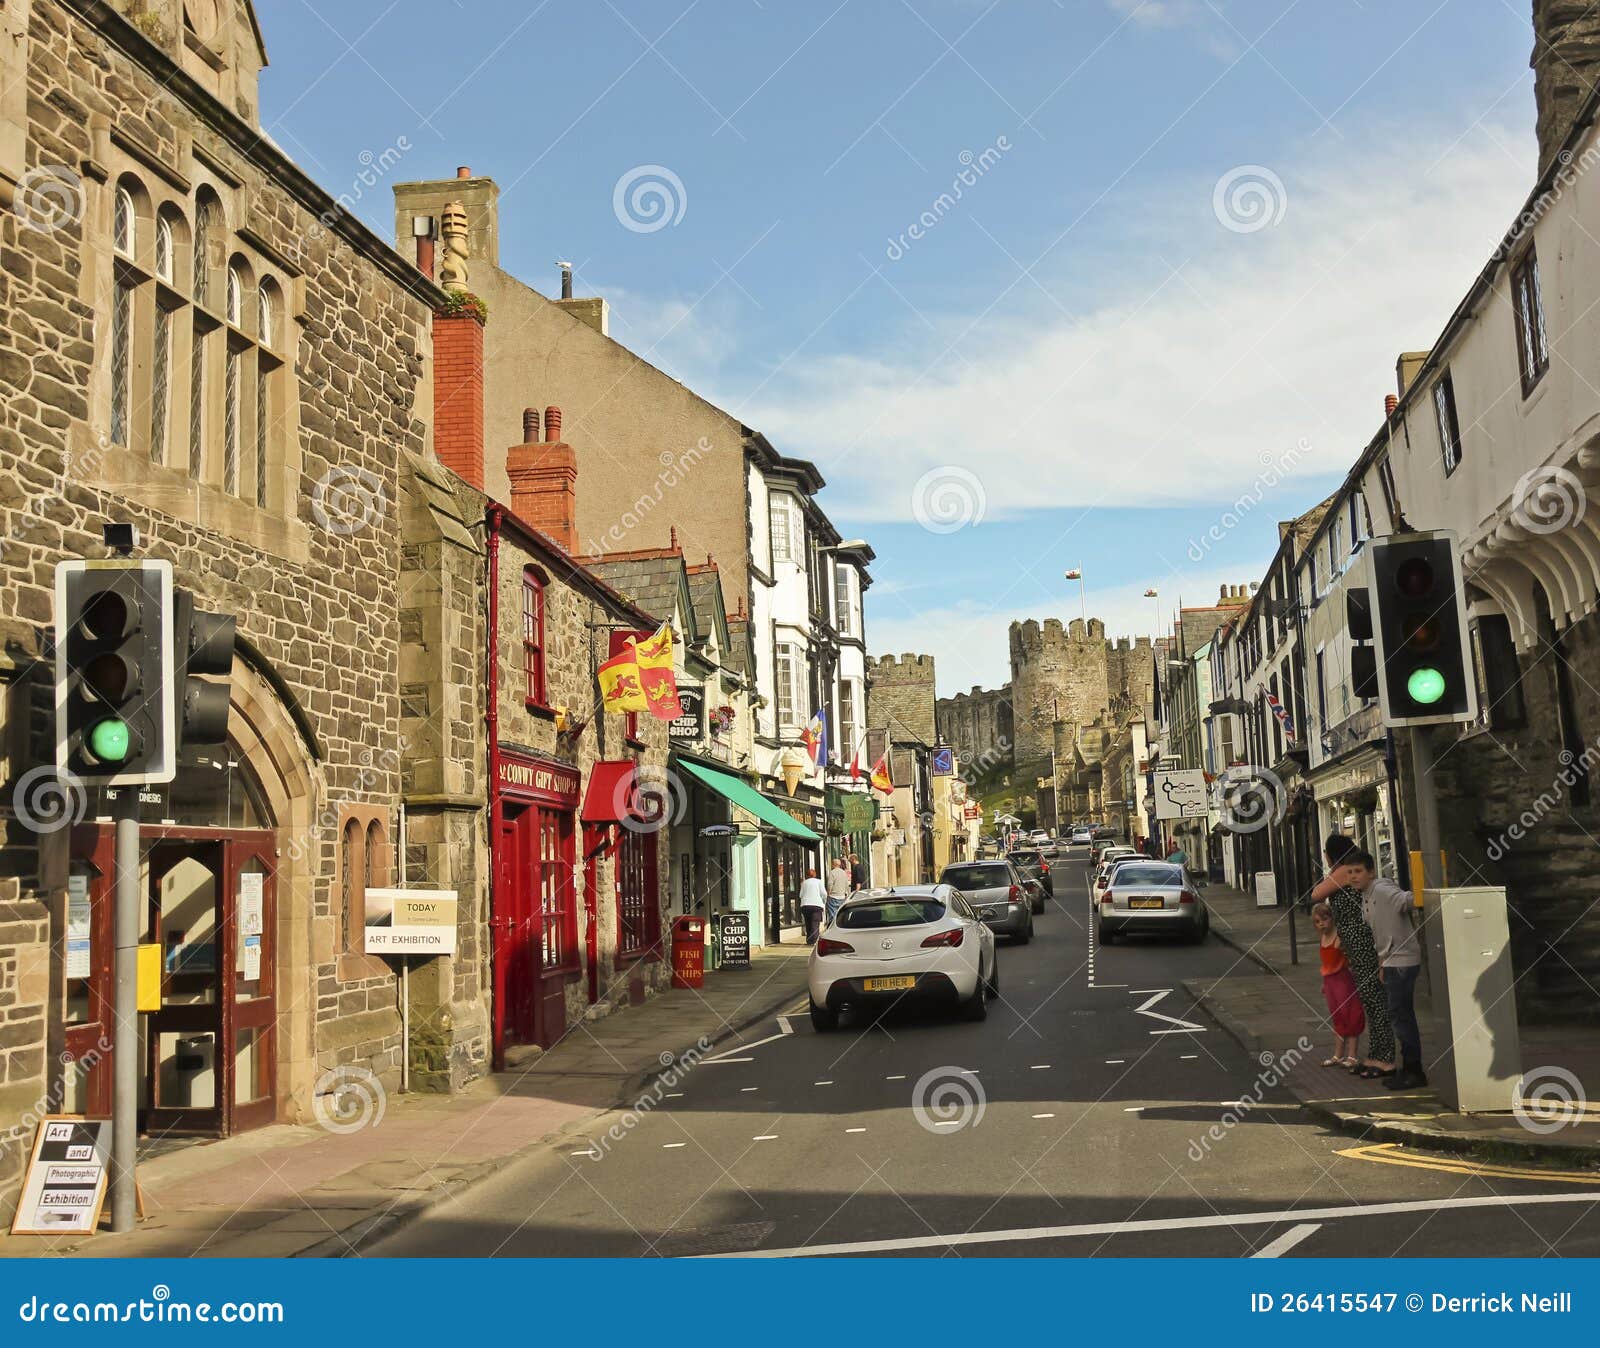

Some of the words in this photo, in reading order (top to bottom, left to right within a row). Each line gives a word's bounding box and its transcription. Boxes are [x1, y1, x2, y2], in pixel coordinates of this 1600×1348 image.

[672, 718, 698, 727] CHIP
[669, 727, 699, 736] SHOP
[507, 763, 533, 786] CONWY
[536, 770, 552, 790] GIFT
[553, 774, 571, 793] SHOP
[407, 903, 437, 912] TODAY
[724, 926, 746, 935] CHIP
[369, 935, 388, 944] ART
[391, 935, 441, 944] EXHIBITION
[722, 935, 748, 945] SHOP
[680, 950, 701, 959] FISH
[686, 960, 694, 968] &
[50, 1127, 68, 1138] Art
[70, 1148, 89, 1158] and
[51, 1169, 96, 1180] Photographic
[43, 1193, 89, 1205] Exhibition
